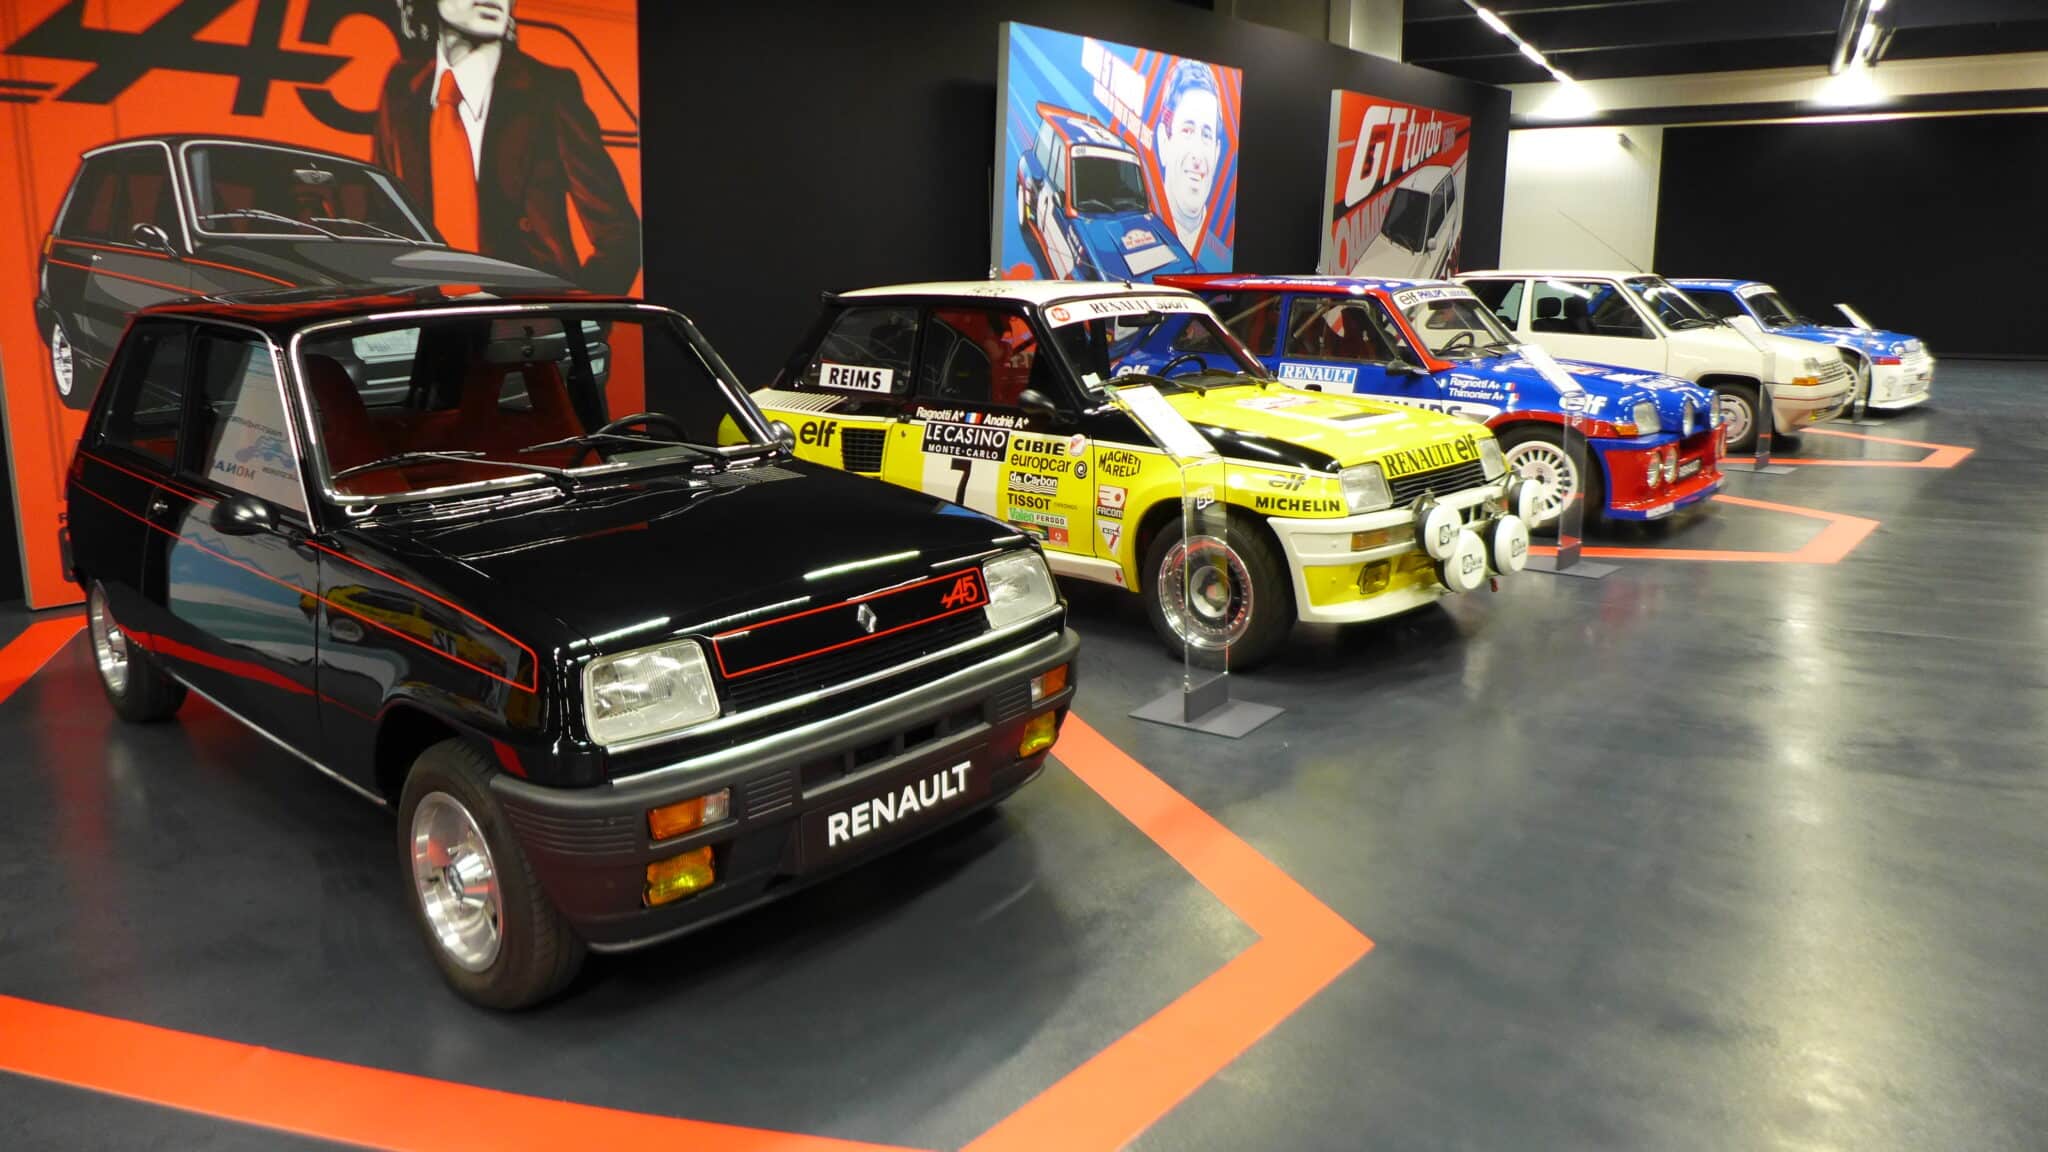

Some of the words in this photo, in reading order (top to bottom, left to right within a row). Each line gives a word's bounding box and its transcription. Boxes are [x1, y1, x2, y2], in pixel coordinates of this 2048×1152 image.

[1344, 105, 1408, 207] GT
[1402, 108, 1443, 173] turbo
[828, 367, 883, 390] REIMS
[1283, 364, 1352, 382] RENAULT
[800, 420, 837, 448] elf
[926, 423, 943, 441] LE
[943, 426, 1006, 448] CASINO
[1013, 438, 1066, 456] CIBIE
[1383, 442, 1456, 477] RENAULT
[1455, 434, 1479, 461] elf
[1010, 453, 1072, 473] europcar
[951, 458, 972, 505] 7
[1010, 471, 1022, 482] de
[1023, 474, 1058, 488] Carbon
[1007, 492, 1051, 511] TISSOT
[1255, 495, 1341, 513] MICHELIN
[1009, 507, 1035, 521] Valeo
[1096, 506, 1123, 519] FACOM
[941, 574, 978, 609] A5
[827, 761, 973, 848] RENAULT
